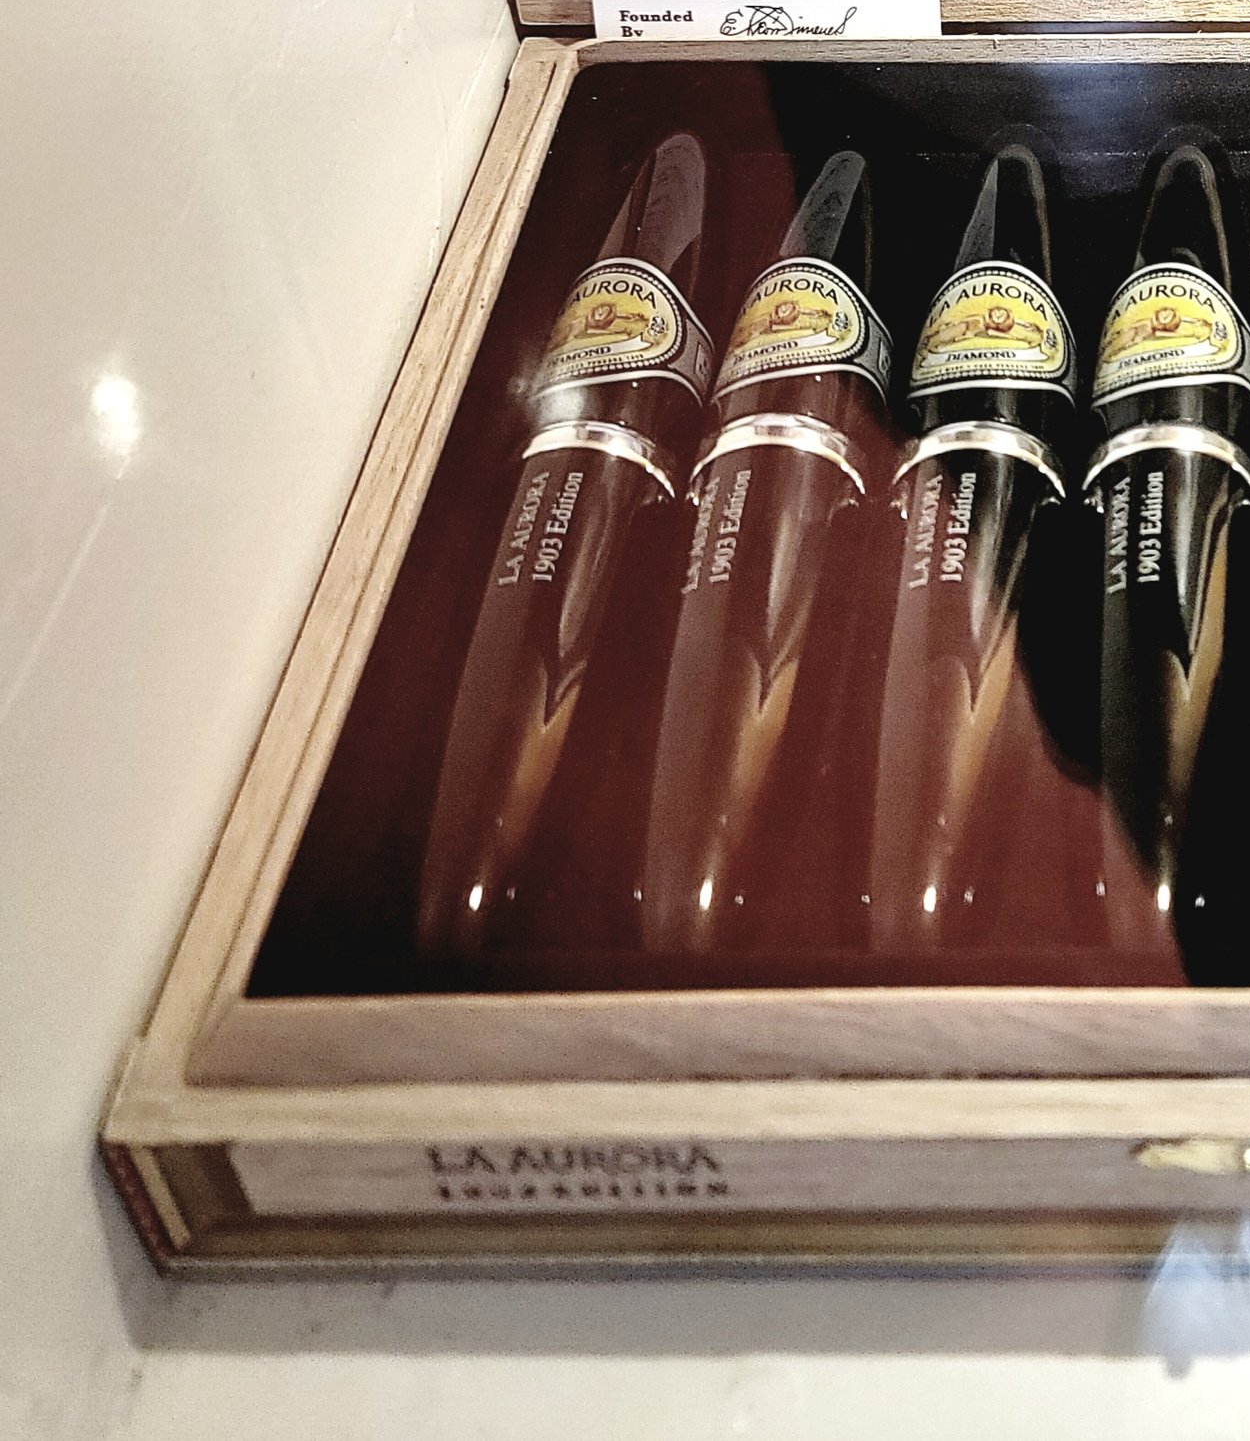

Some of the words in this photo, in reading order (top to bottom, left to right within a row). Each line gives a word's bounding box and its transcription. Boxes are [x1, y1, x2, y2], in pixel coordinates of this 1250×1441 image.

[619, 10, 693, 22] Founded
[570, 280, 658, 309] AURORA
[752, 278, 839, 305] AURORA
[956, 282, 1048, 321] AURORA
[1126, 285, 1217, 314] AURORA
[946, 351, 1017, 363] DIAMOND
[1118, 348, 1186, 370] DIAMOND
[545, 472, 583, 535] Edition
[720, 470, 751, 534] Edition
[918, 474, 942, 555] AURORA
[950, 472, 976, 536] Edition
[1107, 477, 1131, 556] AURORA
[1141, 472, 1164, 534] Edition
[498, 554, 525, 585] LA
[533, 538, 563, 582] 1903
[709, 537, 737, 582] 1903
[910, 559, 932, 589] LA
[941, 538, 967, 583] 1903
[1106, 559, 1128, 593] LA
[1138, 537, 1162, 583] 1903
